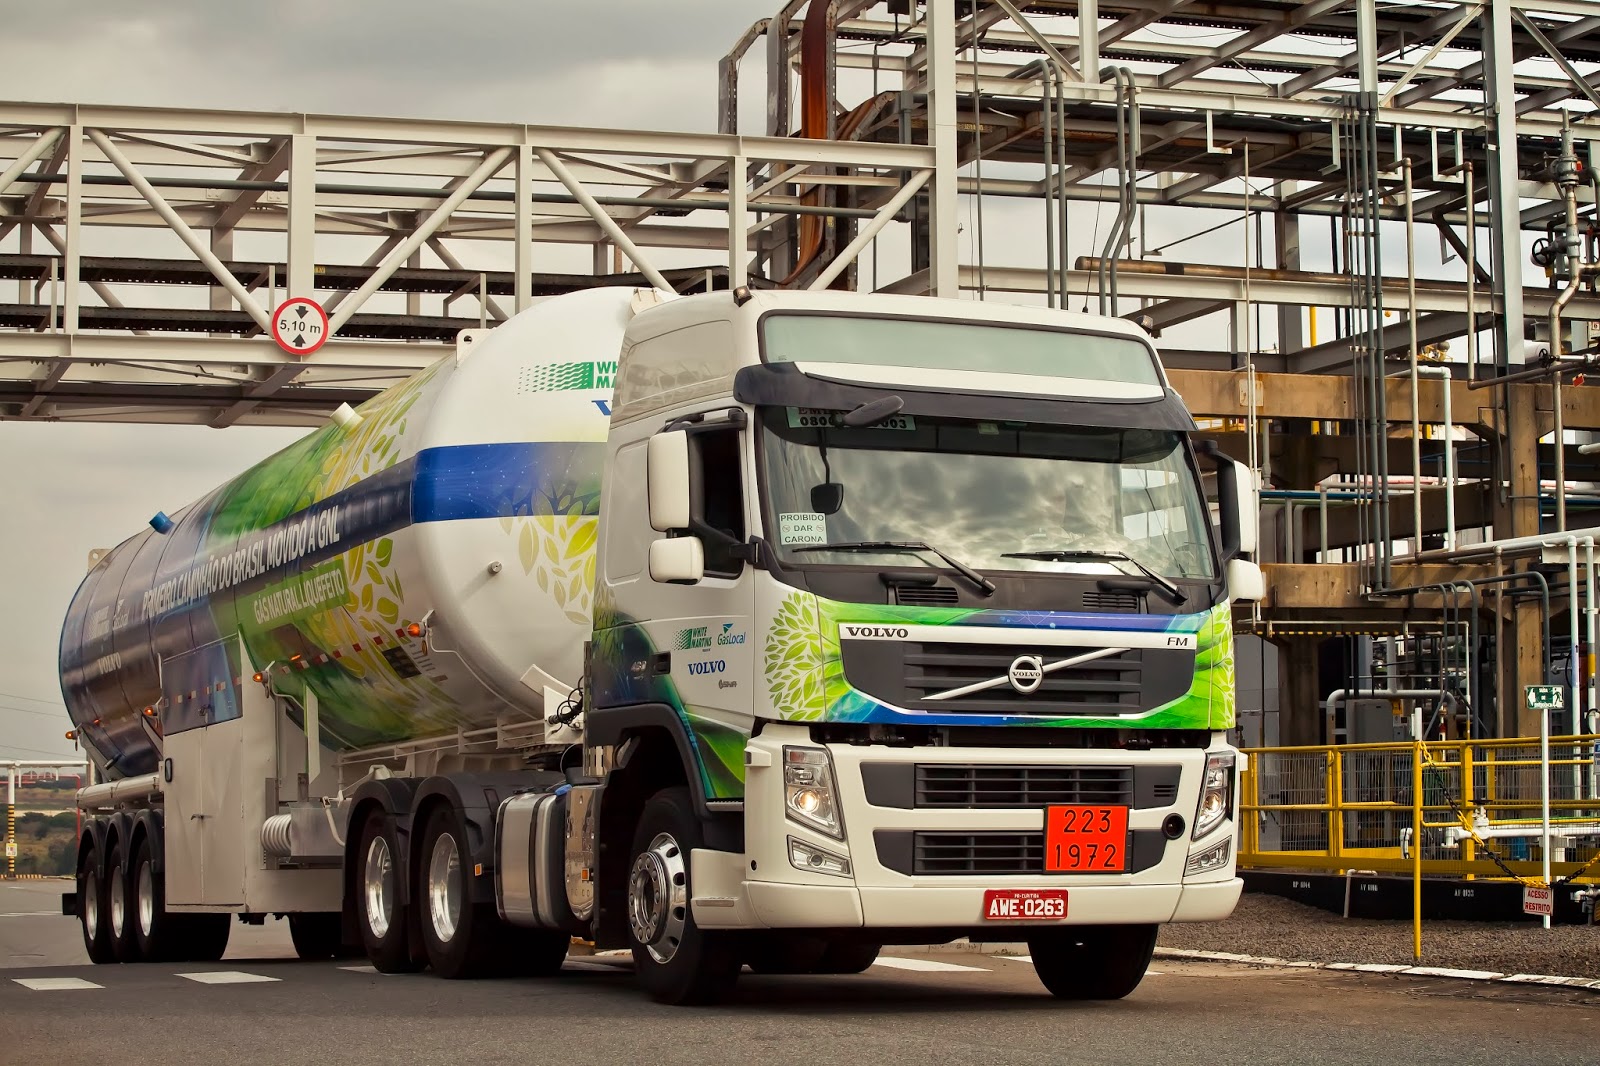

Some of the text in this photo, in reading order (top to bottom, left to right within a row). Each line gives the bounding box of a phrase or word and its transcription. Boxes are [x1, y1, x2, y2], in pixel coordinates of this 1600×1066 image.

[280, 319, 321, 334] 5,10 m
[780, 514, 824, 522] PROIBIDO
[784, 534, 824, 543] CARONA
[141, 577, 177, 623] PRIMEIRO
[177, 554, 219, 606] CAMINHÃO
[219, 553, 233, 590] DO
[232, 540, 265, 586] BRASIL
[266, 520, 308, 571] MOVIDO
[308, 515, 316, 554] A
[318, 505, 340, 549] GNL
[267, 586, 302, 619] NATURAL
[300, 568, 345, 609] LIQUEFEITO
[692, 626, 708, 638] WHITE
[717, 631, 746, 646] GasLocal
[846, 626, 909, 639] VOLVO
[691, 636, 712, 649] MARTINS
[1167, 636, 1189, 647] FM
[687, 659, 726, 676] VOLVO
[1063, 809, 1112, 833] 223
[1055, 843, 1117, 868] 1972
[1527, 890, 1549, 900] ACESSO
[1525, 901, 1551, 912] RESTRITO
